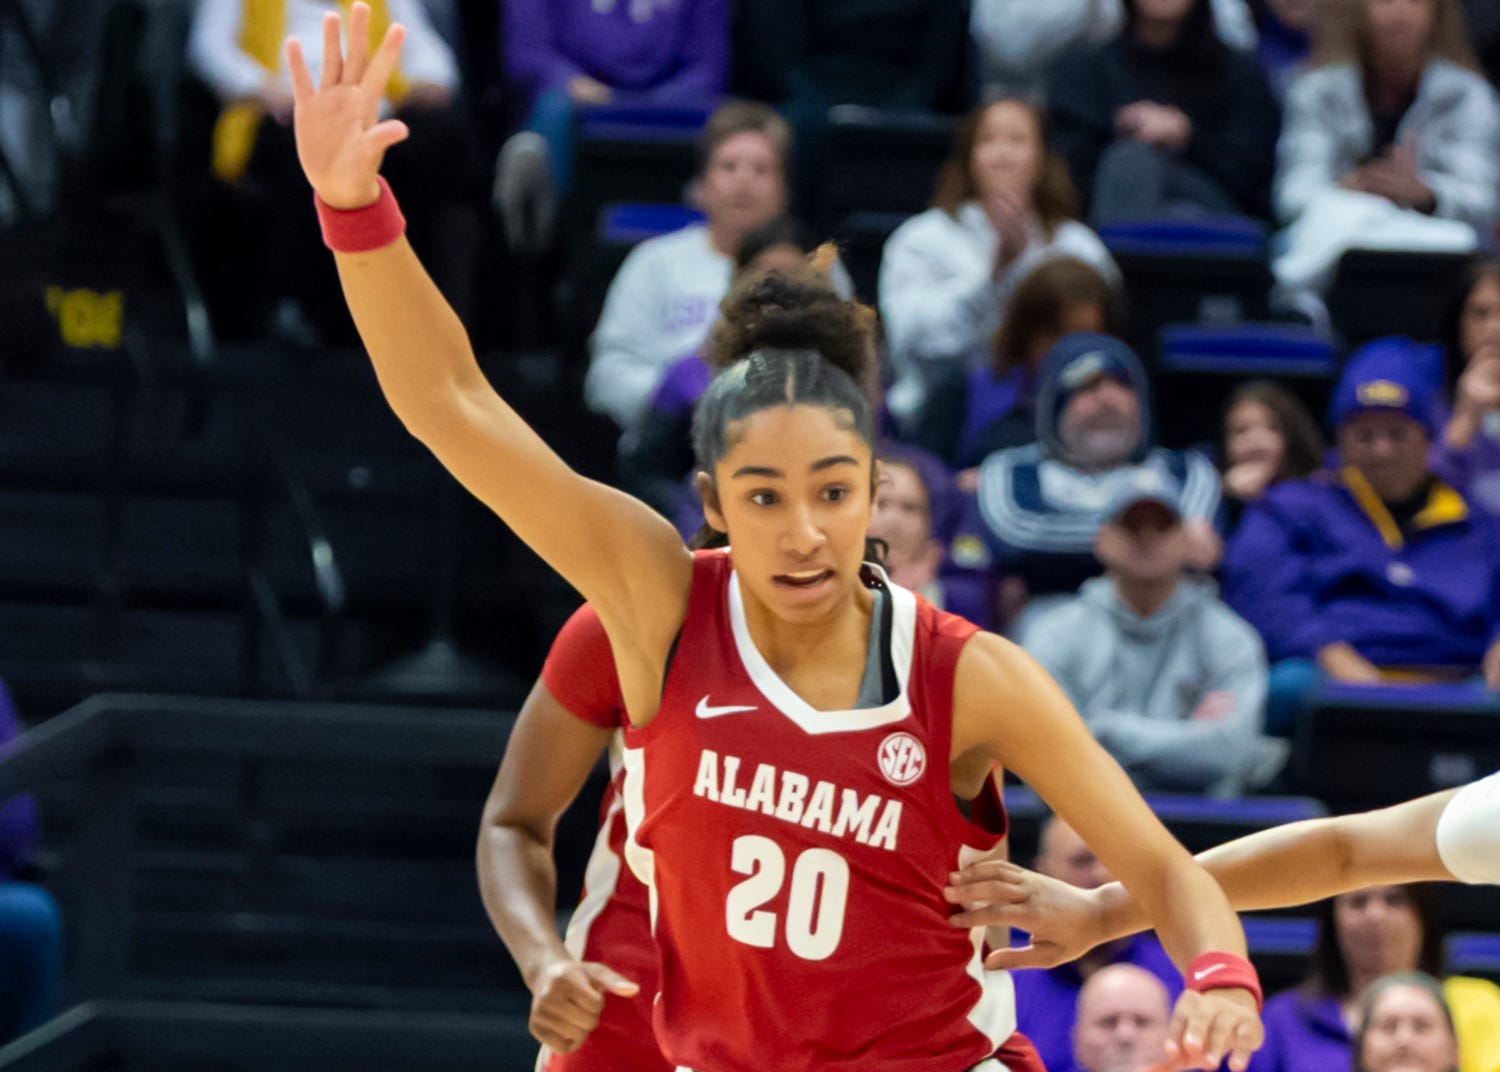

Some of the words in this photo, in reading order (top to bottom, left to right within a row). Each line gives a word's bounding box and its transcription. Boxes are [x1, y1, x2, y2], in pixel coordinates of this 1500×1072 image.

[693, 749, 903, 851] ALABAMA
[880, 735, 924, 785] SEC
[725, 834, 850, 961] 20
